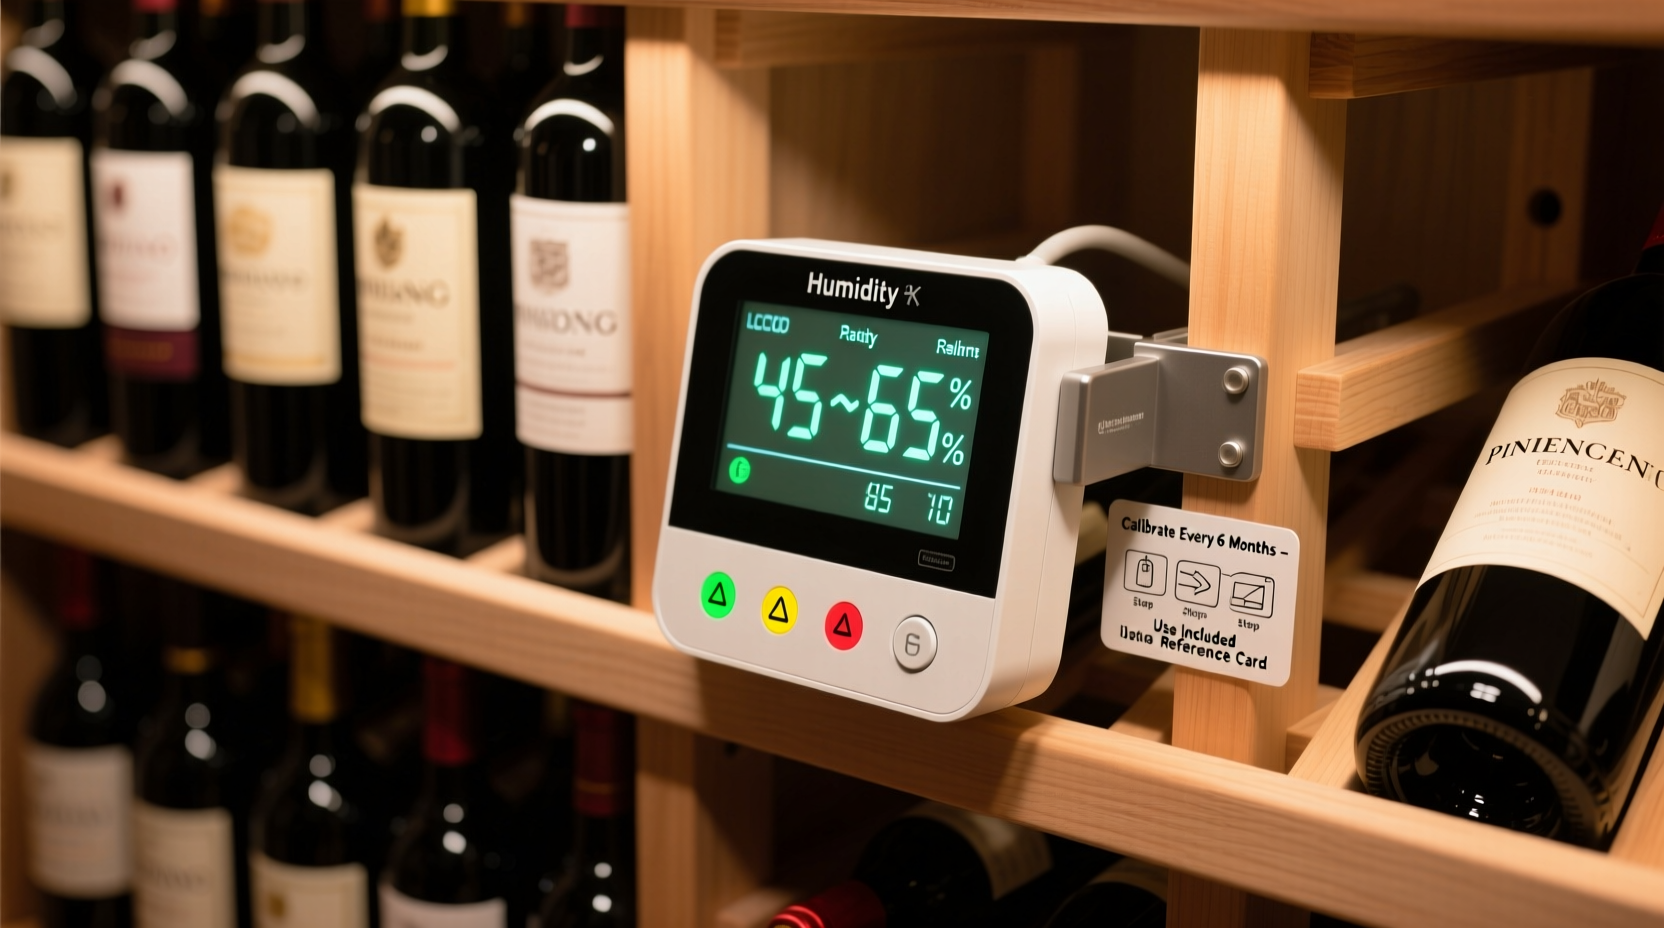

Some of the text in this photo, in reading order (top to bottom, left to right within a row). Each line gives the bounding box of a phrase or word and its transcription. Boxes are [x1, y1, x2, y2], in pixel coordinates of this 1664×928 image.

[806, 271, 899, 309] Humidity
[864, 481, 894, 514] 85
[1179, 527, 1214, 549] Every
[1216, 533, 1226, 547] 6
[1229, 535, 1277, 557] Months
[1154, 618, 1237, 648] Use Included
[1160, 635, 1231, 663] Reference
[1235, 651, 1268, 670] Card
